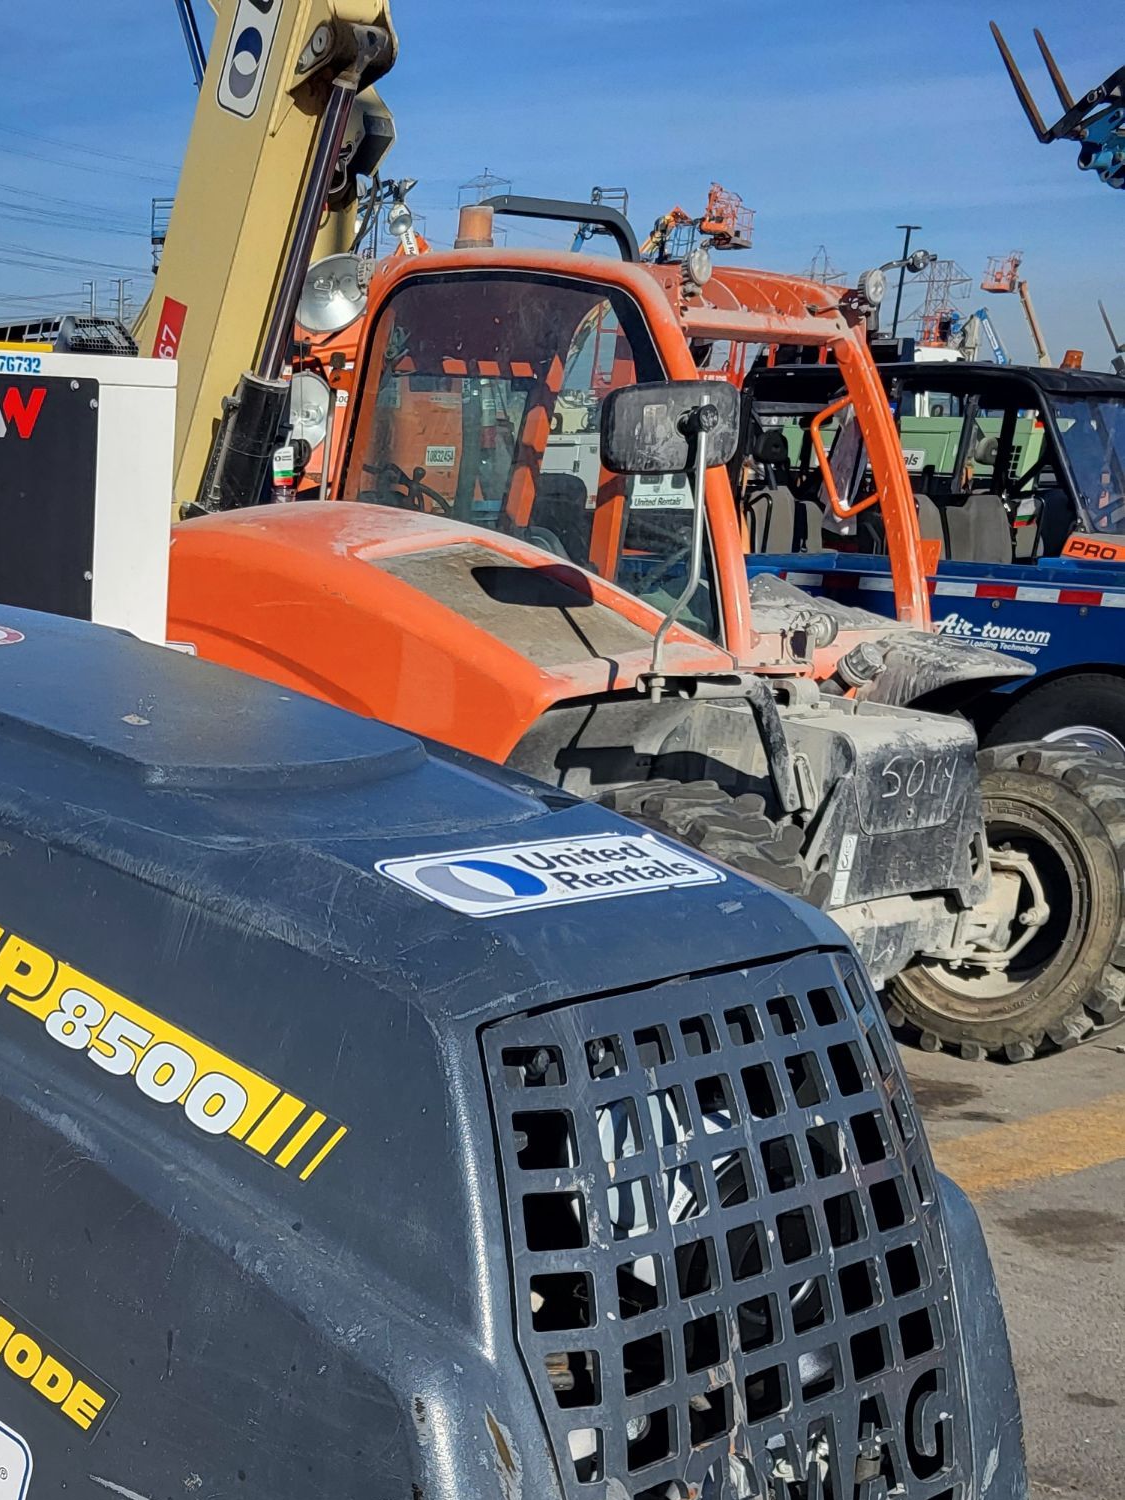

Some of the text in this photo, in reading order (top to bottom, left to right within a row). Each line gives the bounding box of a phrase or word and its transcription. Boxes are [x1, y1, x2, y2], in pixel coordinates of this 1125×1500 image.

[634, 497, 657, 507] United
[1068, 540, 1117, 560] PRO
[934, 613, 1051, 643] Air-tow.com
[513, 842, 647, 871] United
[549, 859, 699, 891] Rentals
